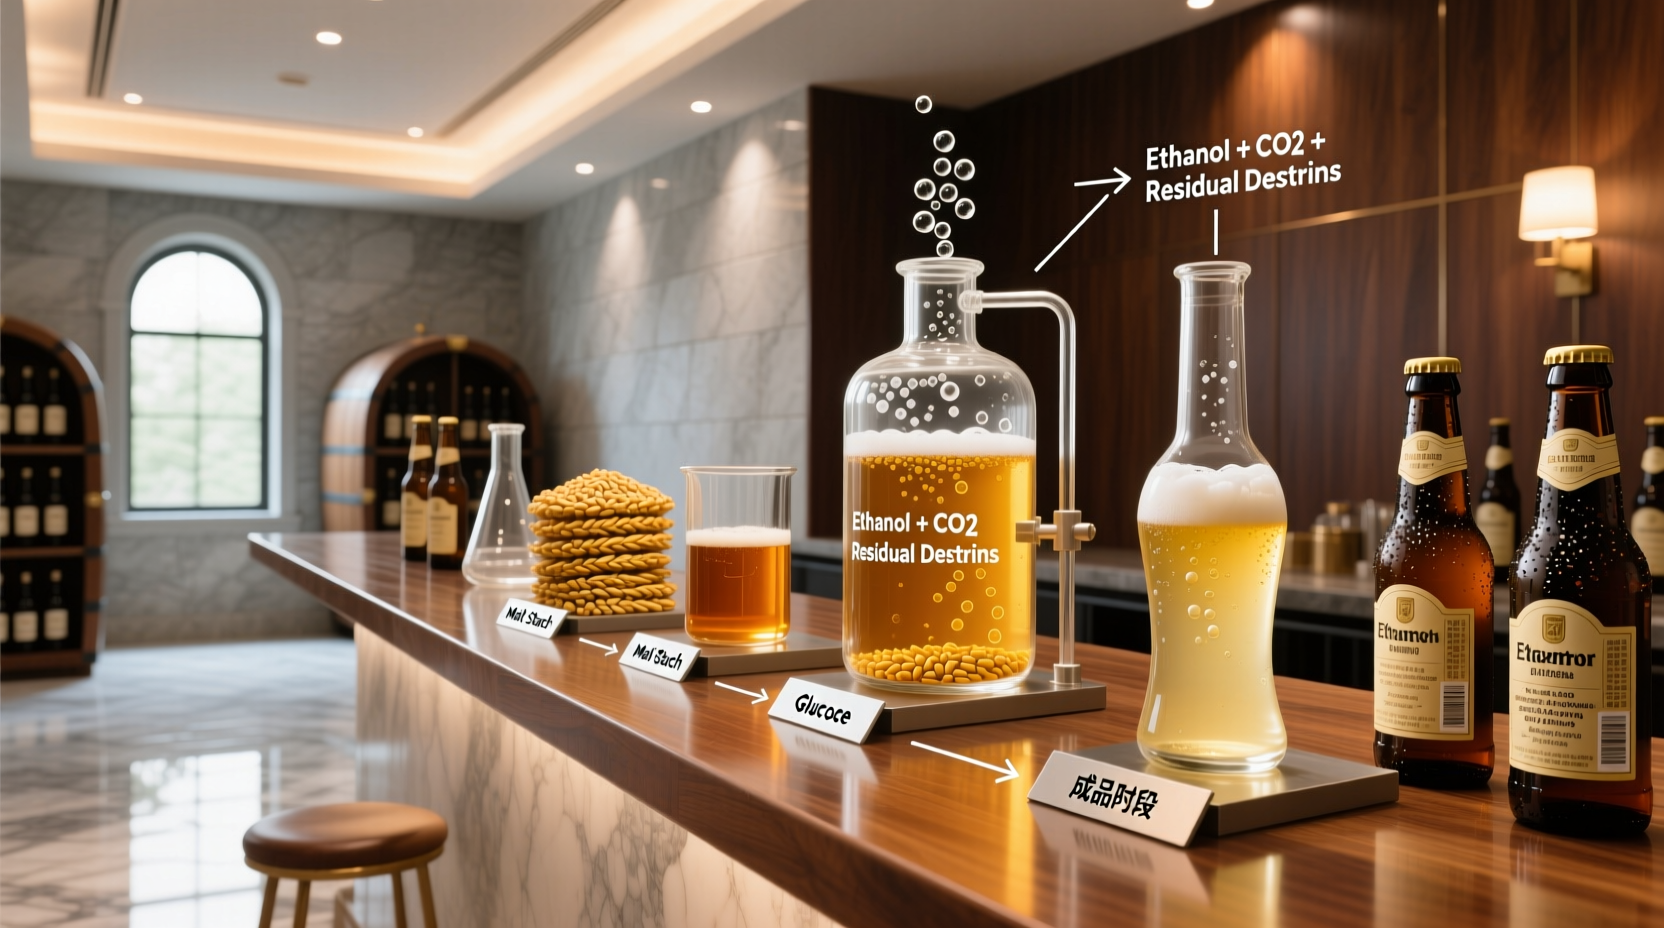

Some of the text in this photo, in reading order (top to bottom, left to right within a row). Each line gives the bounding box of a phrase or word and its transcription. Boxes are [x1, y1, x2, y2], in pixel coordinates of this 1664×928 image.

[795, 693, 852, 725] Glucoce
[1068, 773, 1159, 820] 成品时段
